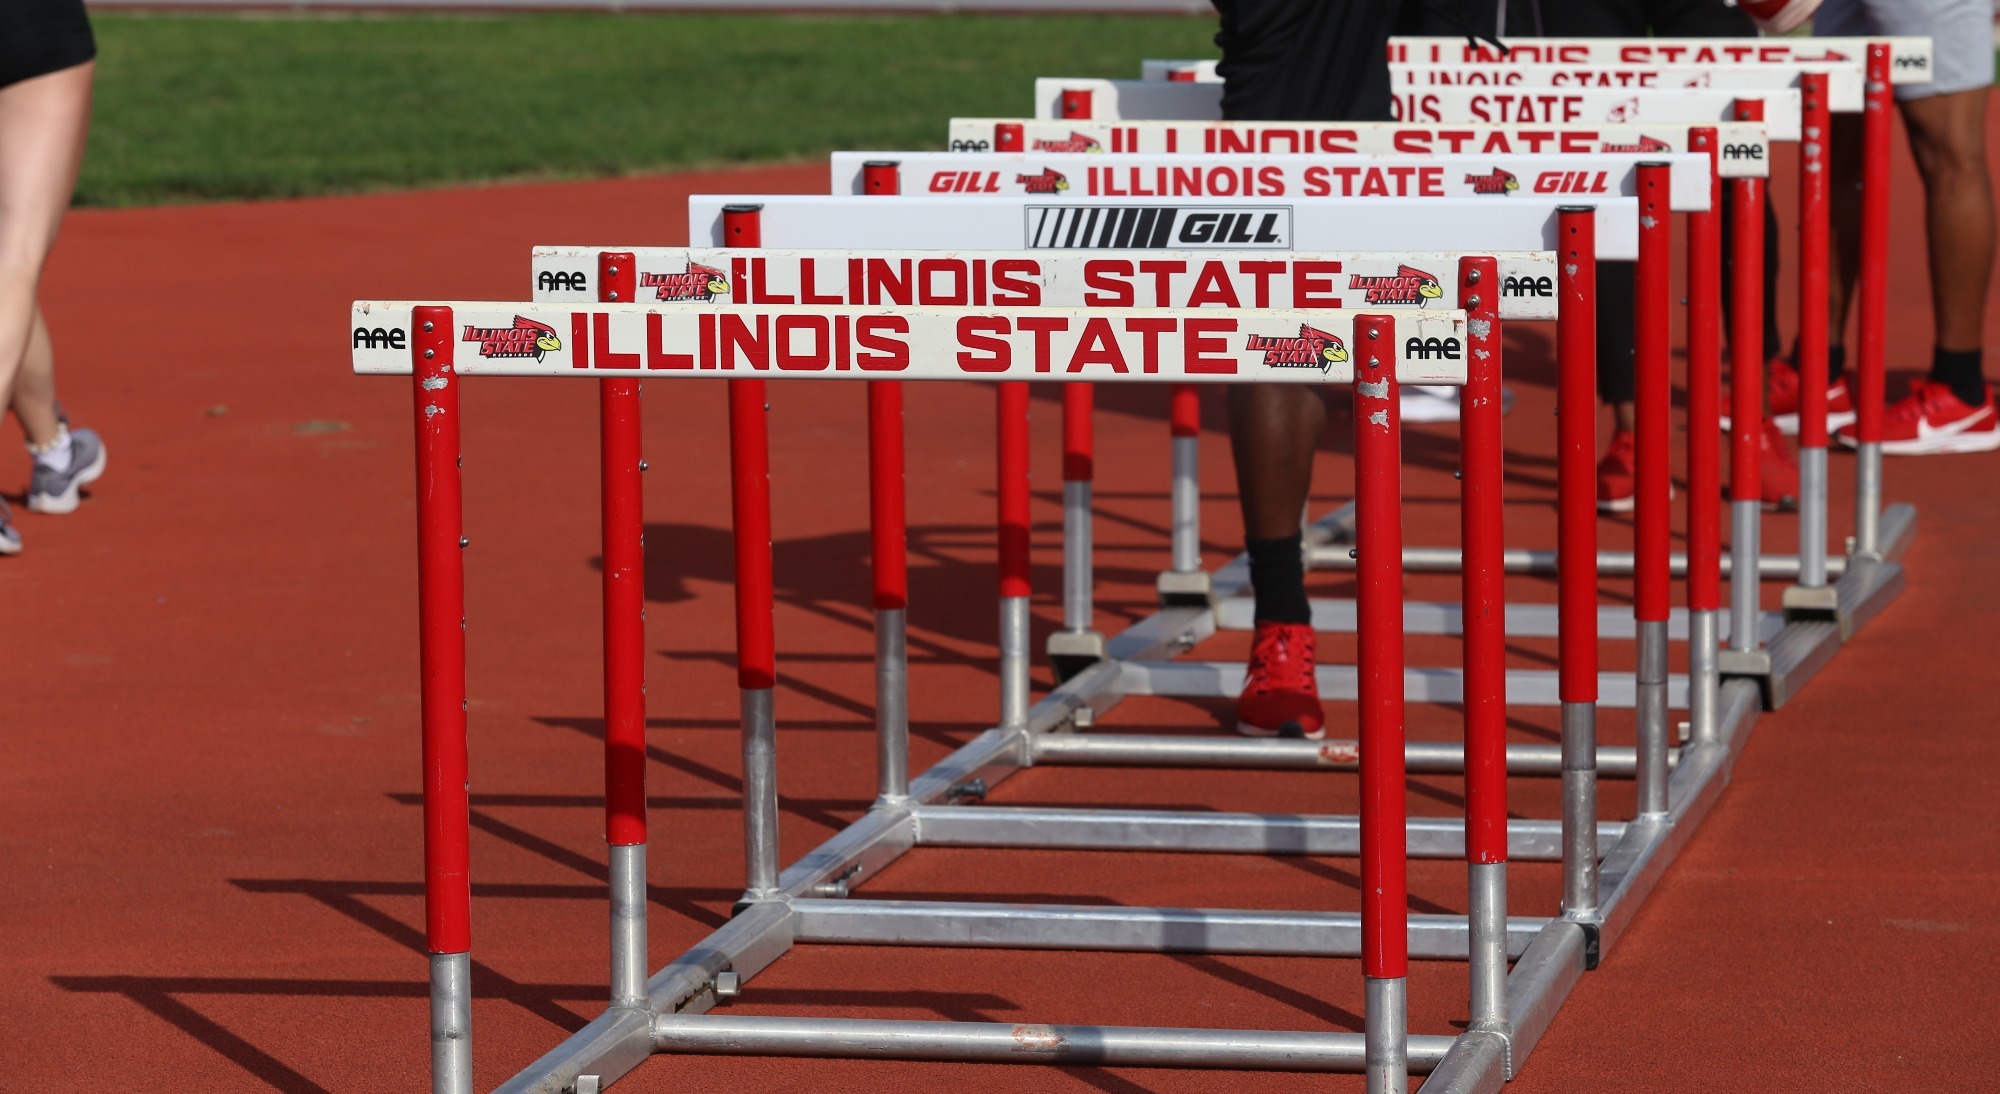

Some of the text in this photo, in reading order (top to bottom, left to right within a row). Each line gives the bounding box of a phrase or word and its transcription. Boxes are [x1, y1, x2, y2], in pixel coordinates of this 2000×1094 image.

[1111, 127, 1599, 154] ILLINOIS STATE
[928, 171, 1001, 193] GILL
[1088, 166, 1445, 197] ILLINOIS STATE
[1533, 171, 1609, 193] GILL
[1178, 213, 1280, 243] GILL
[640, 271, 710, 288] ILLINOIS
[731, 258, 1342, 308] ILLINOIS STATE
[1349, 274, 1421, 289] ILLINOIS
[656, 285, 708, 299] STATE
[1365, 288, 1418, 302] STATE
[462, 325, 538, 342] ILLINOIS
[1246, 334, 1324, 350] ILLINOIS
[480, 341, 536, 355] STATE
[571, 312, 1238, 374] ILLINOIS STATE
[1264, 350, 1322, 365] STATE
